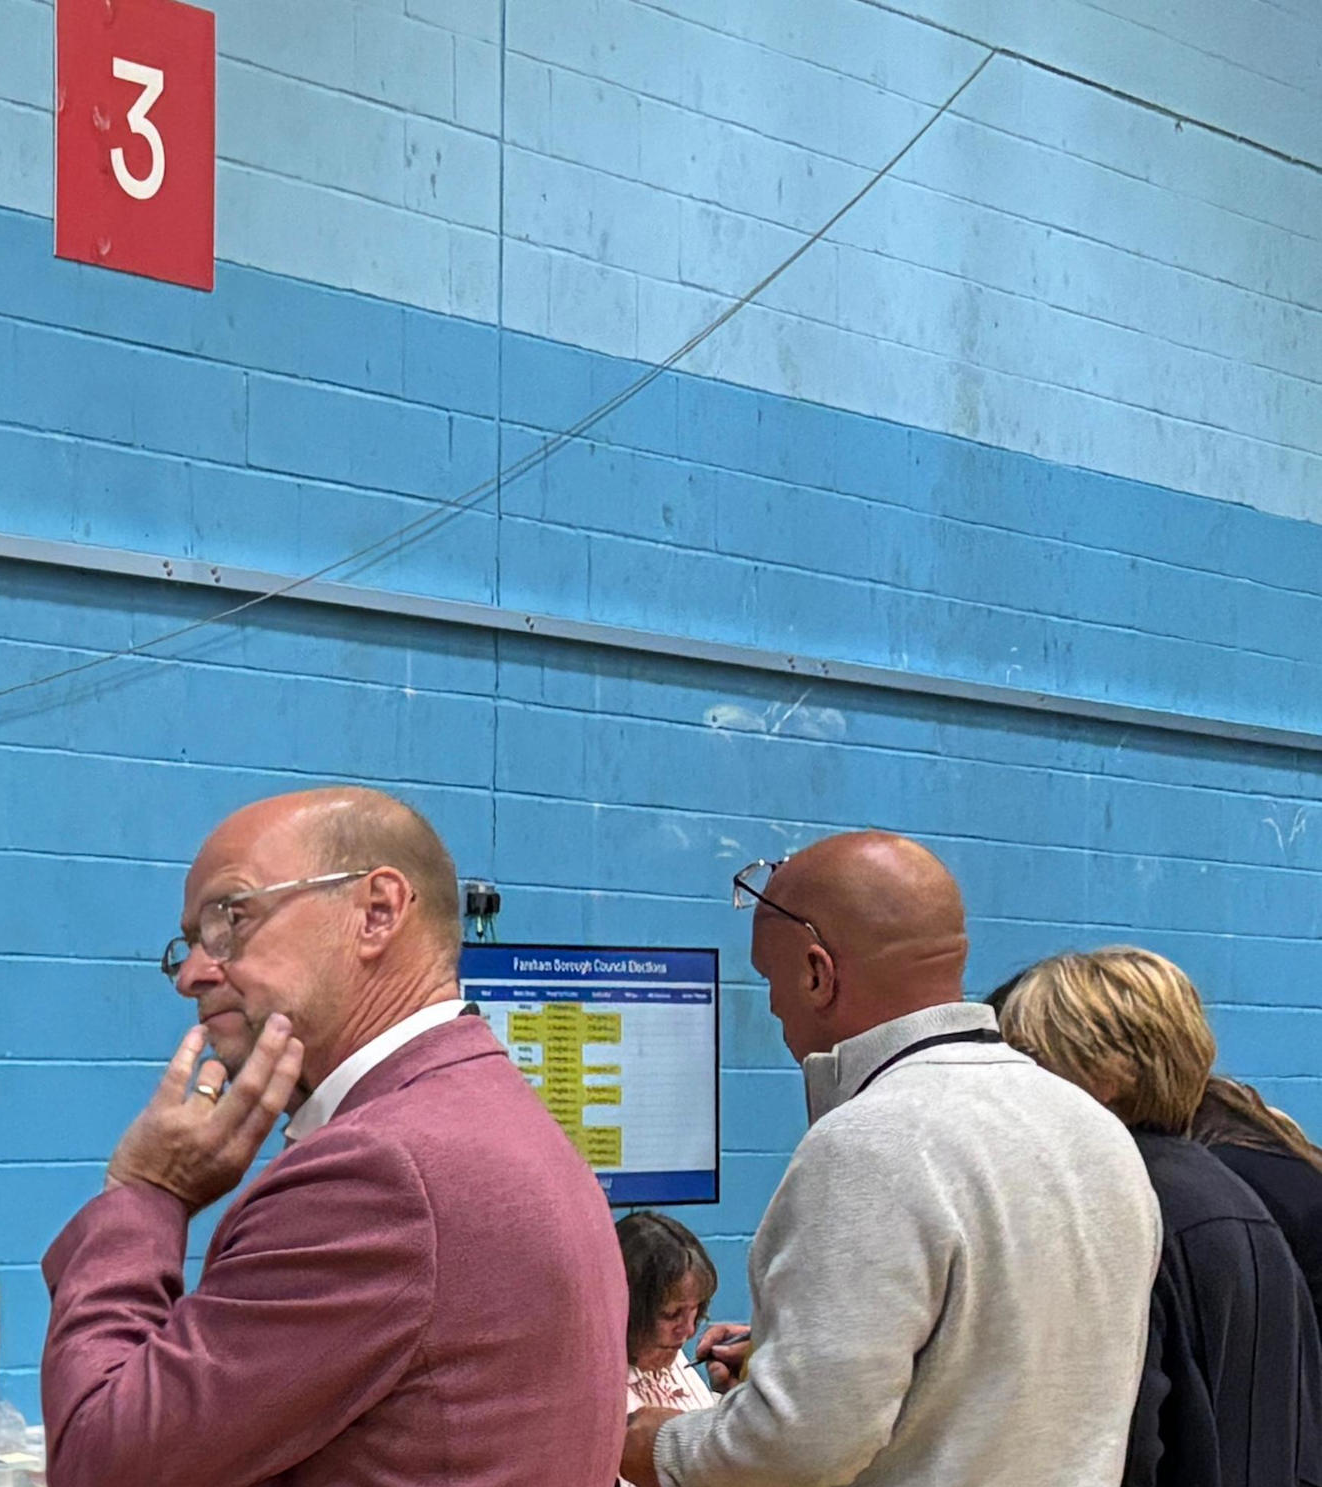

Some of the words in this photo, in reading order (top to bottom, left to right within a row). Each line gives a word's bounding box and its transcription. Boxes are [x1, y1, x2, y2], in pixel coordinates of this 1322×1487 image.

[110, 56, 165, 200] 3
[553, 958, 592, 975] Borough
[593, 958, 627, 973] Council
[628, 960, 667, 974] Elections
